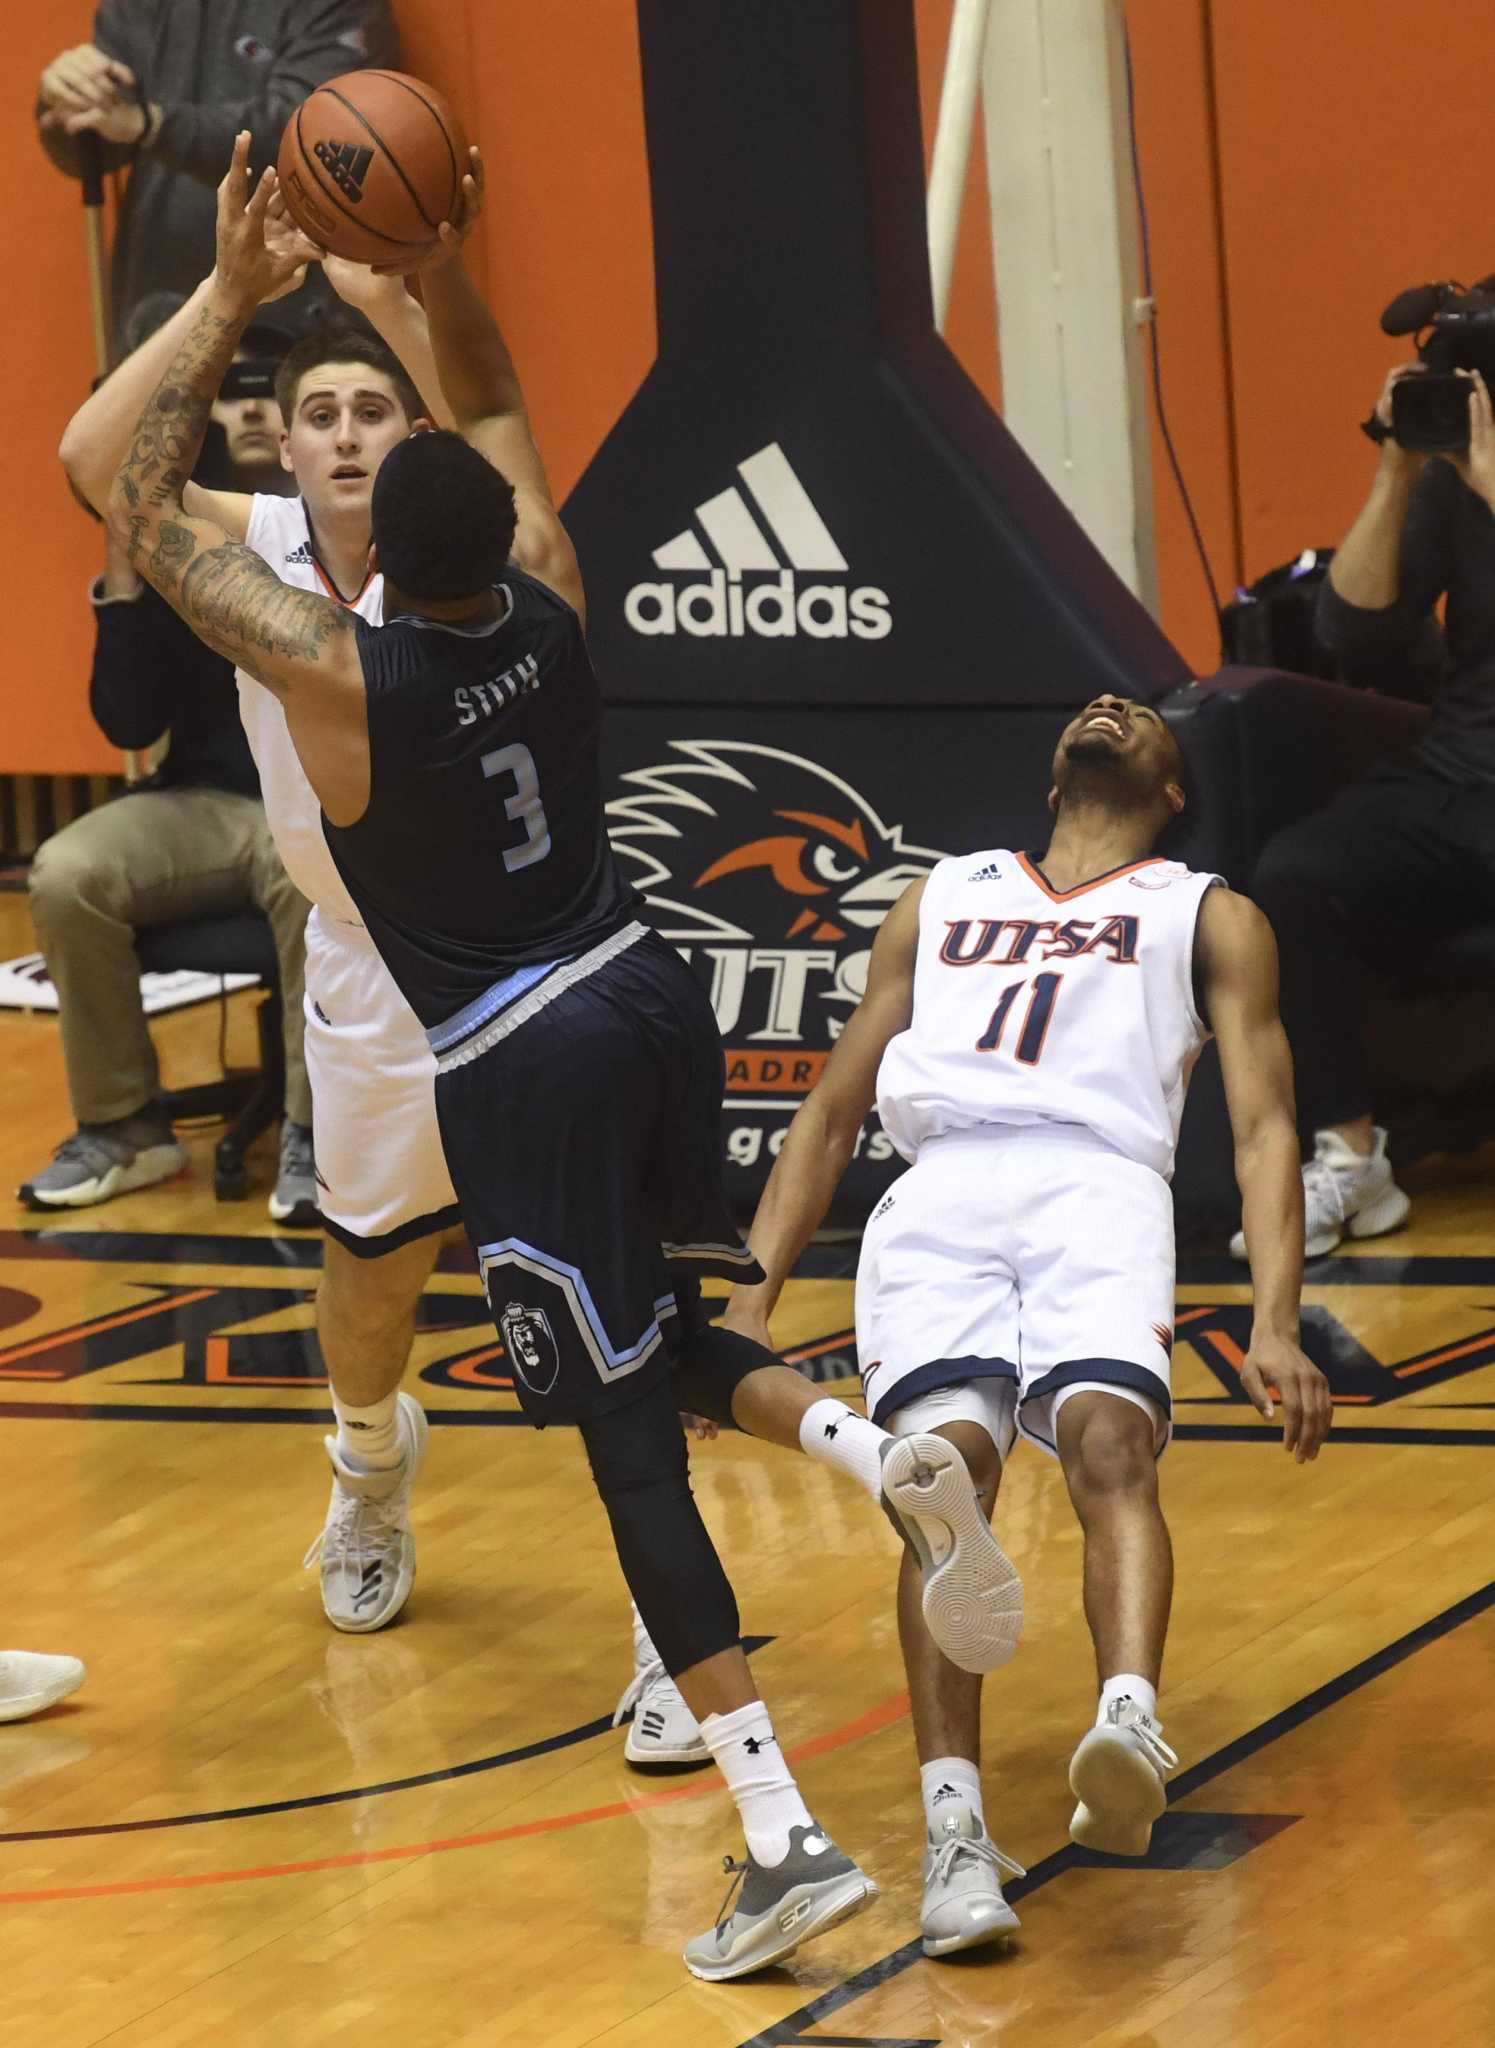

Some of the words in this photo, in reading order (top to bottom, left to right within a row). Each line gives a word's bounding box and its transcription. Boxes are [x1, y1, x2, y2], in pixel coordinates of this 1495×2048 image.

[624, 567, 893, 640] adidas
[454, 653, 540, 725] STITH
[480, 742, 551, 873] 3
[939, 915, 1139, 967] UTSA
[975, 971, 1064, 1066] 11
